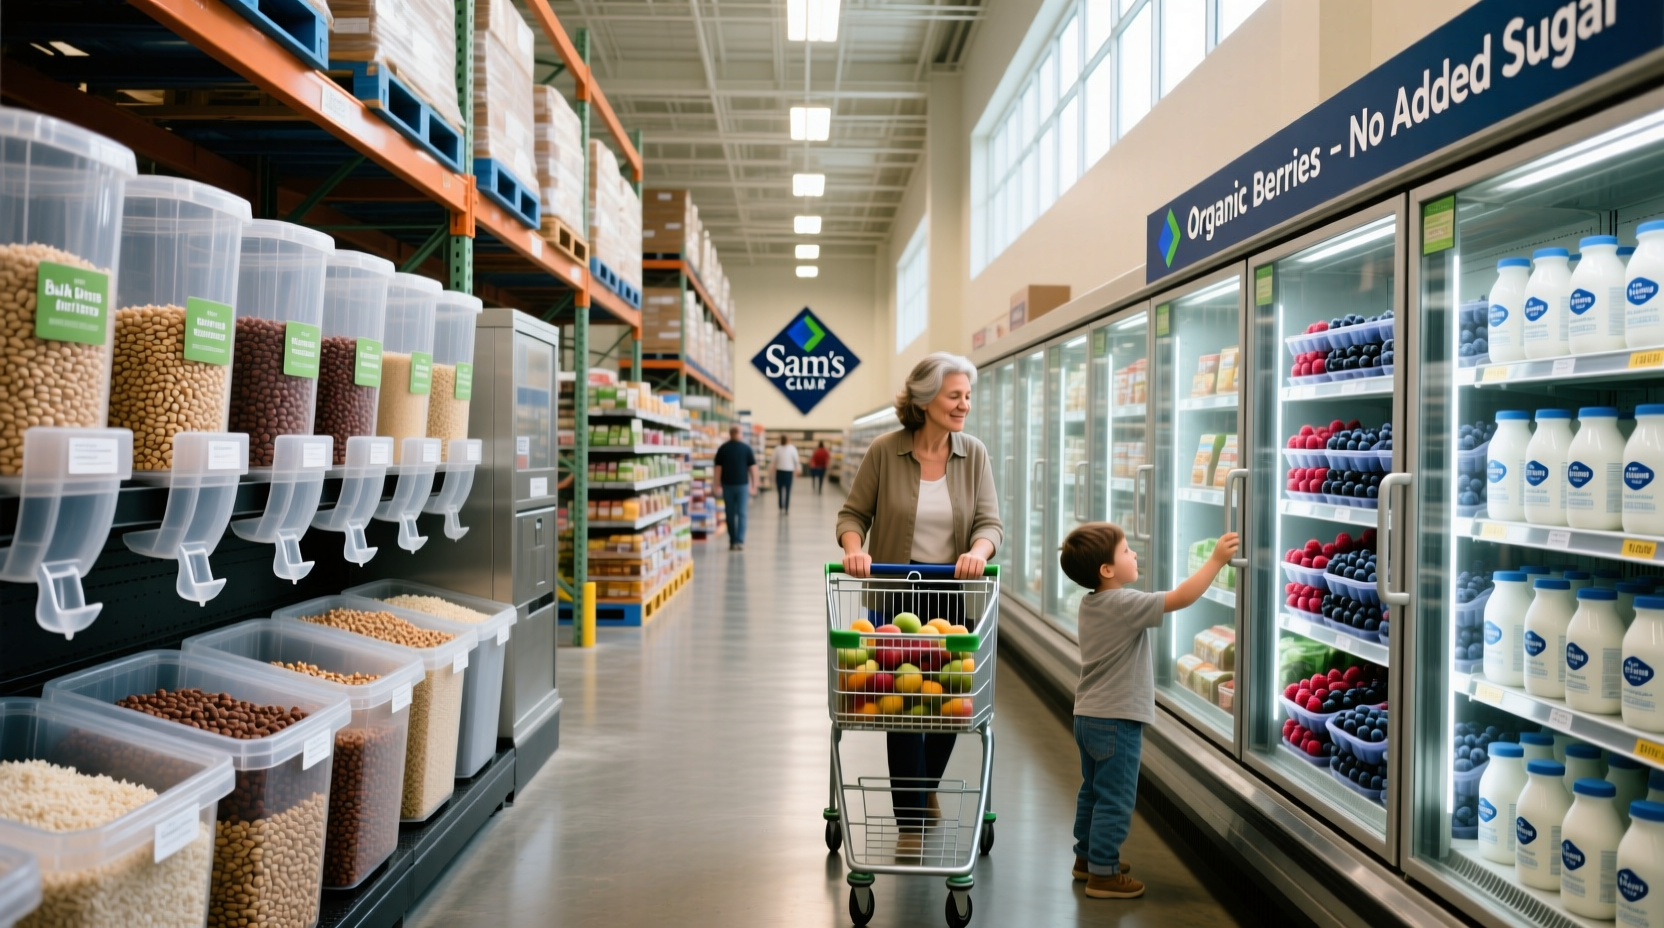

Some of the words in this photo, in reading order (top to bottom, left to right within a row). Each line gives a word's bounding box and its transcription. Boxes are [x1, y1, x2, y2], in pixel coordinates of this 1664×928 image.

[1187, 179, 1248, 242] Organic
[1252, 146, 1321, 208] Berries
[1349, 107, 1385, 158] No
[1390, 33, 1492, 137] Added
[765, 344, 846, 378] Sam's
